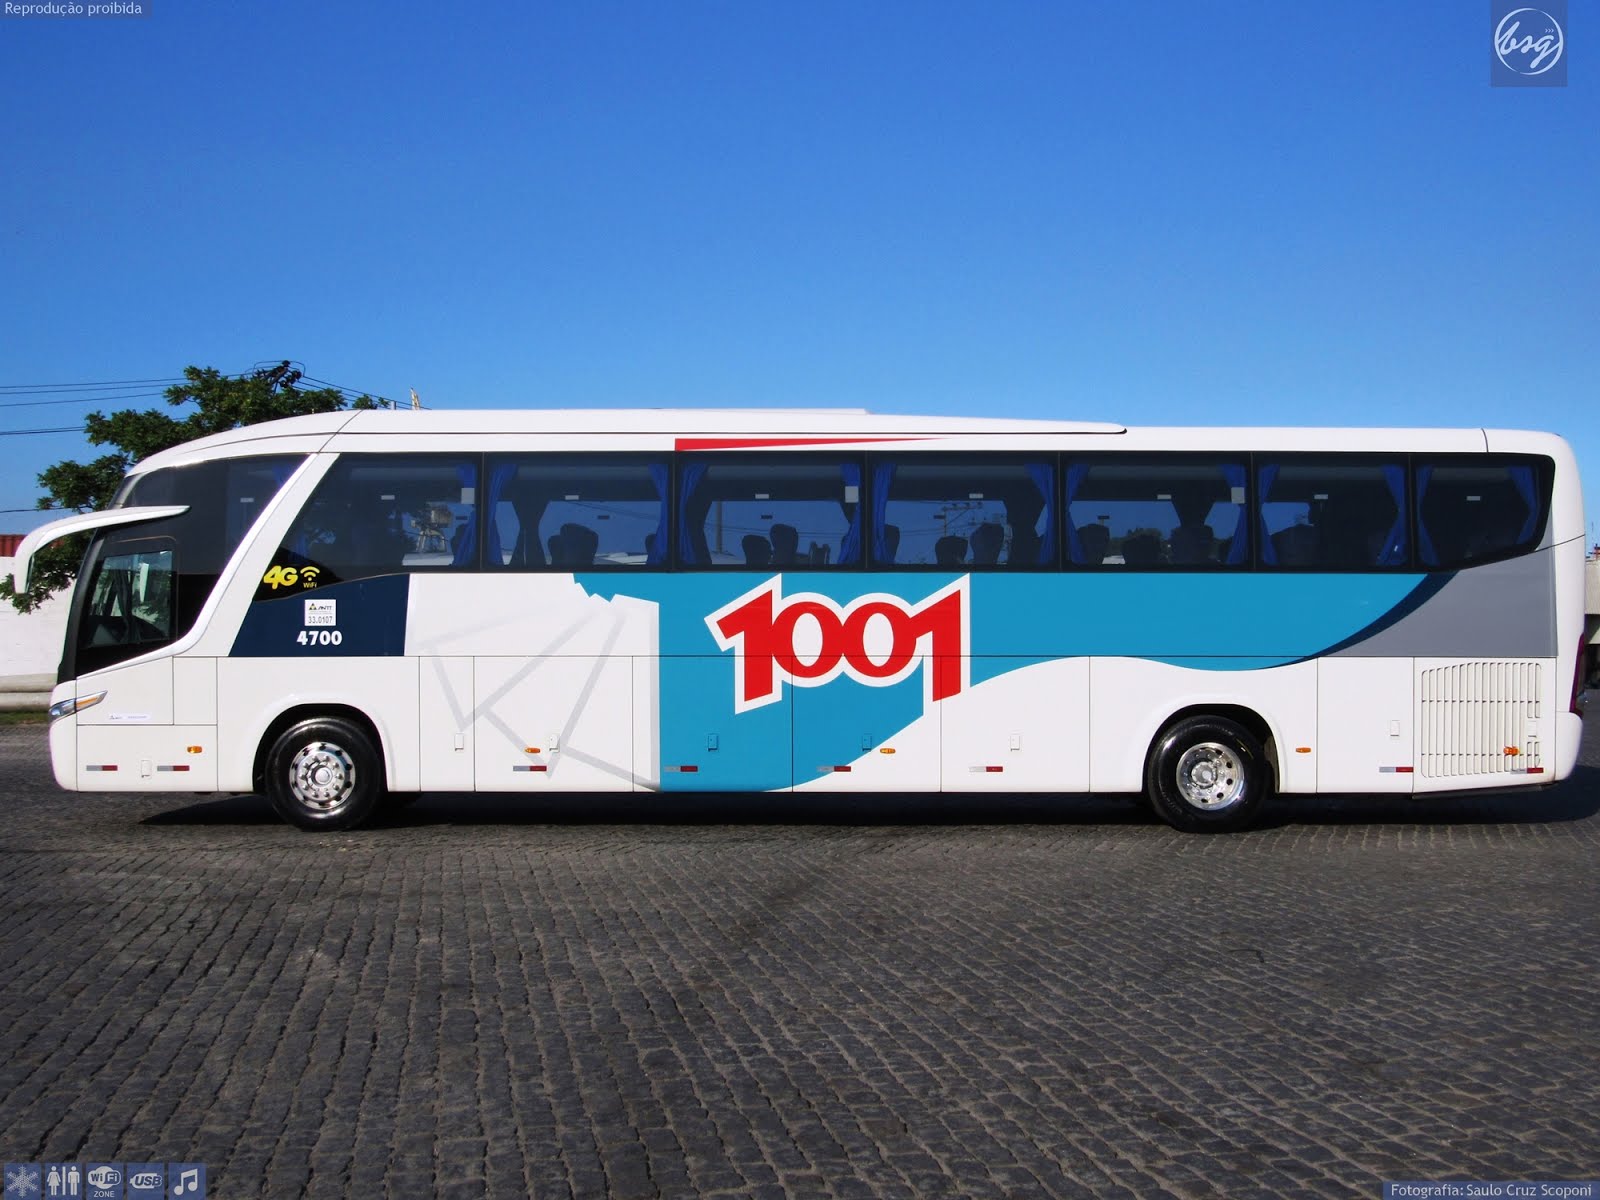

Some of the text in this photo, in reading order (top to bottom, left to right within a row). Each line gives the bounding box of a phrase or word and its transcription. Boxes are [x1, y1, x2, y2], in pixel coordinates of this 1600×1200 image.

[263, 565, 298, 589] 4G
[296, 630, 342, 645] 4700
[712, 584, 963, 704] 1001
